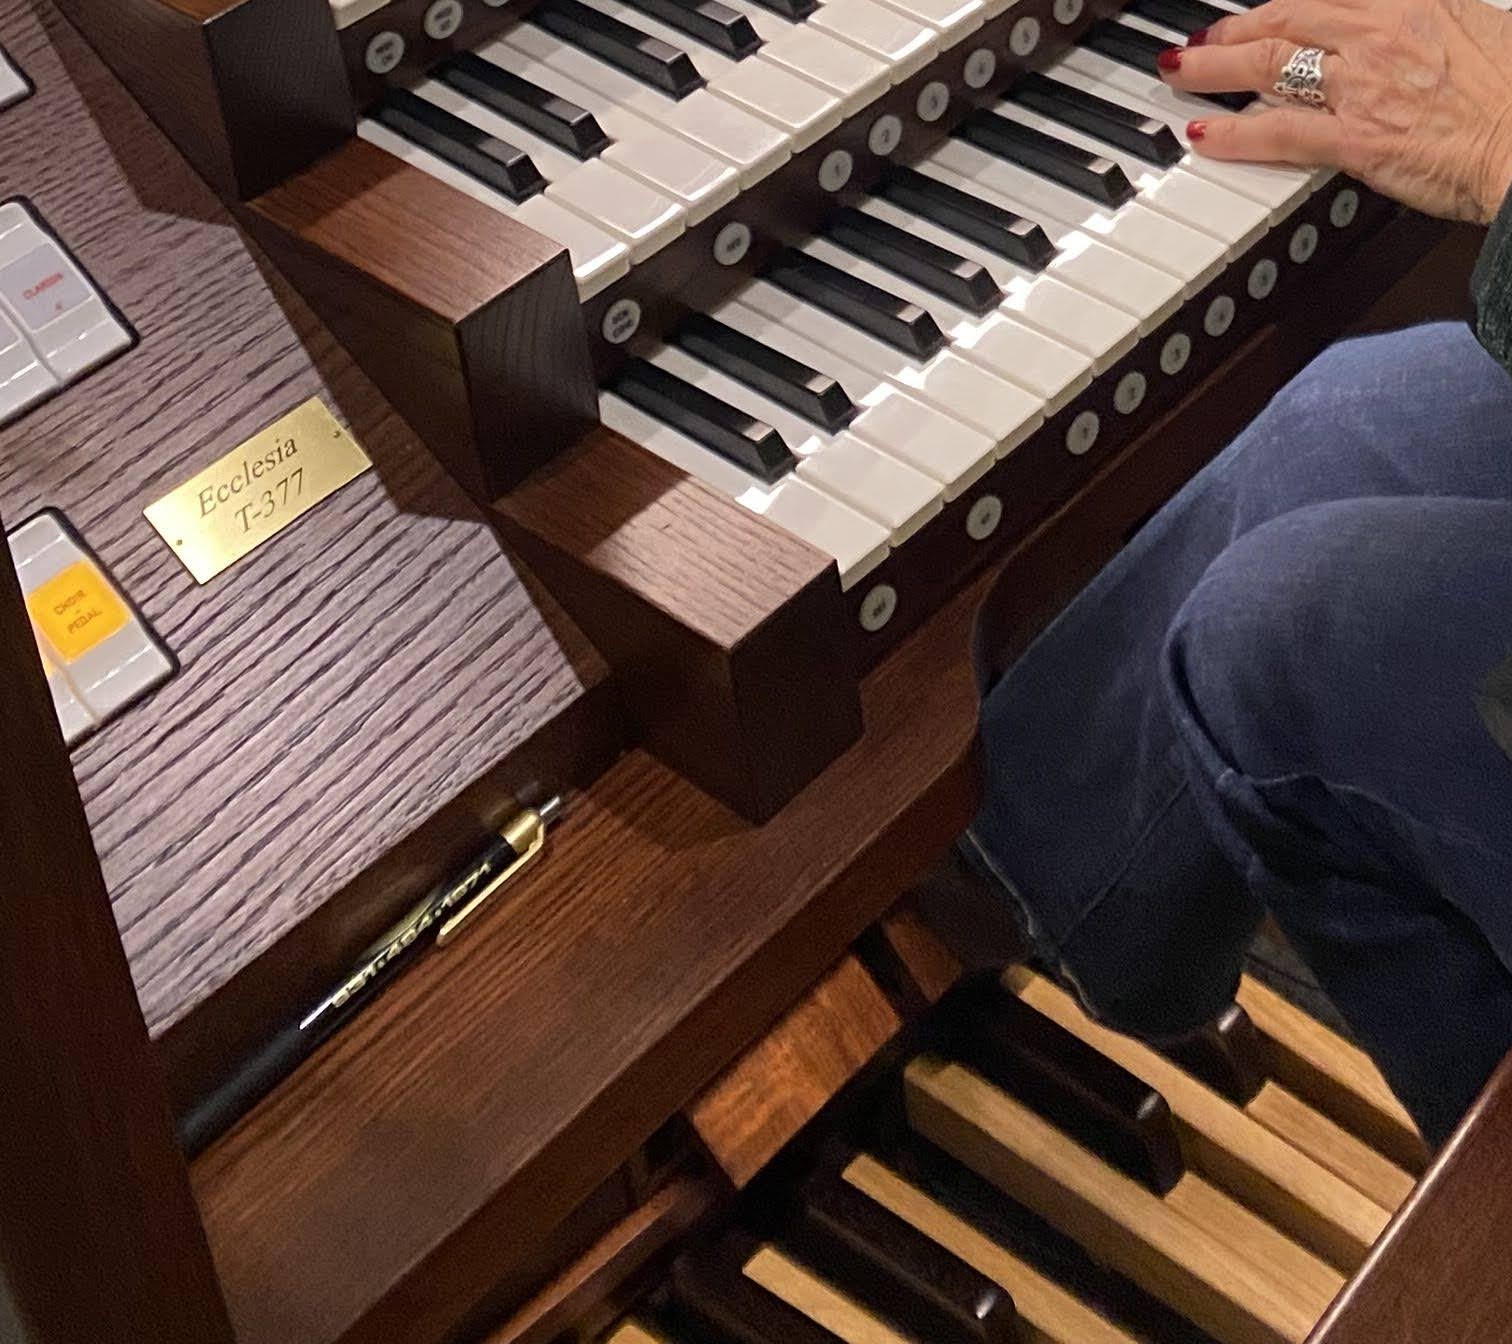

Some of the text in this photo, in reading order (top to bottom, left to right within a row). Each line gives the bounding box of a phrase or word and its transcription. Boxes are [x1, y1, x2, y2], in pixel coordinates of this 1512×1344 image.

[197, 436, 299, 518] Ecclesia
[234, 467, 303, 534] T-377
[53, 589, 87, 616] CHOIR
[67, 609, 104, 635] PEDAL
